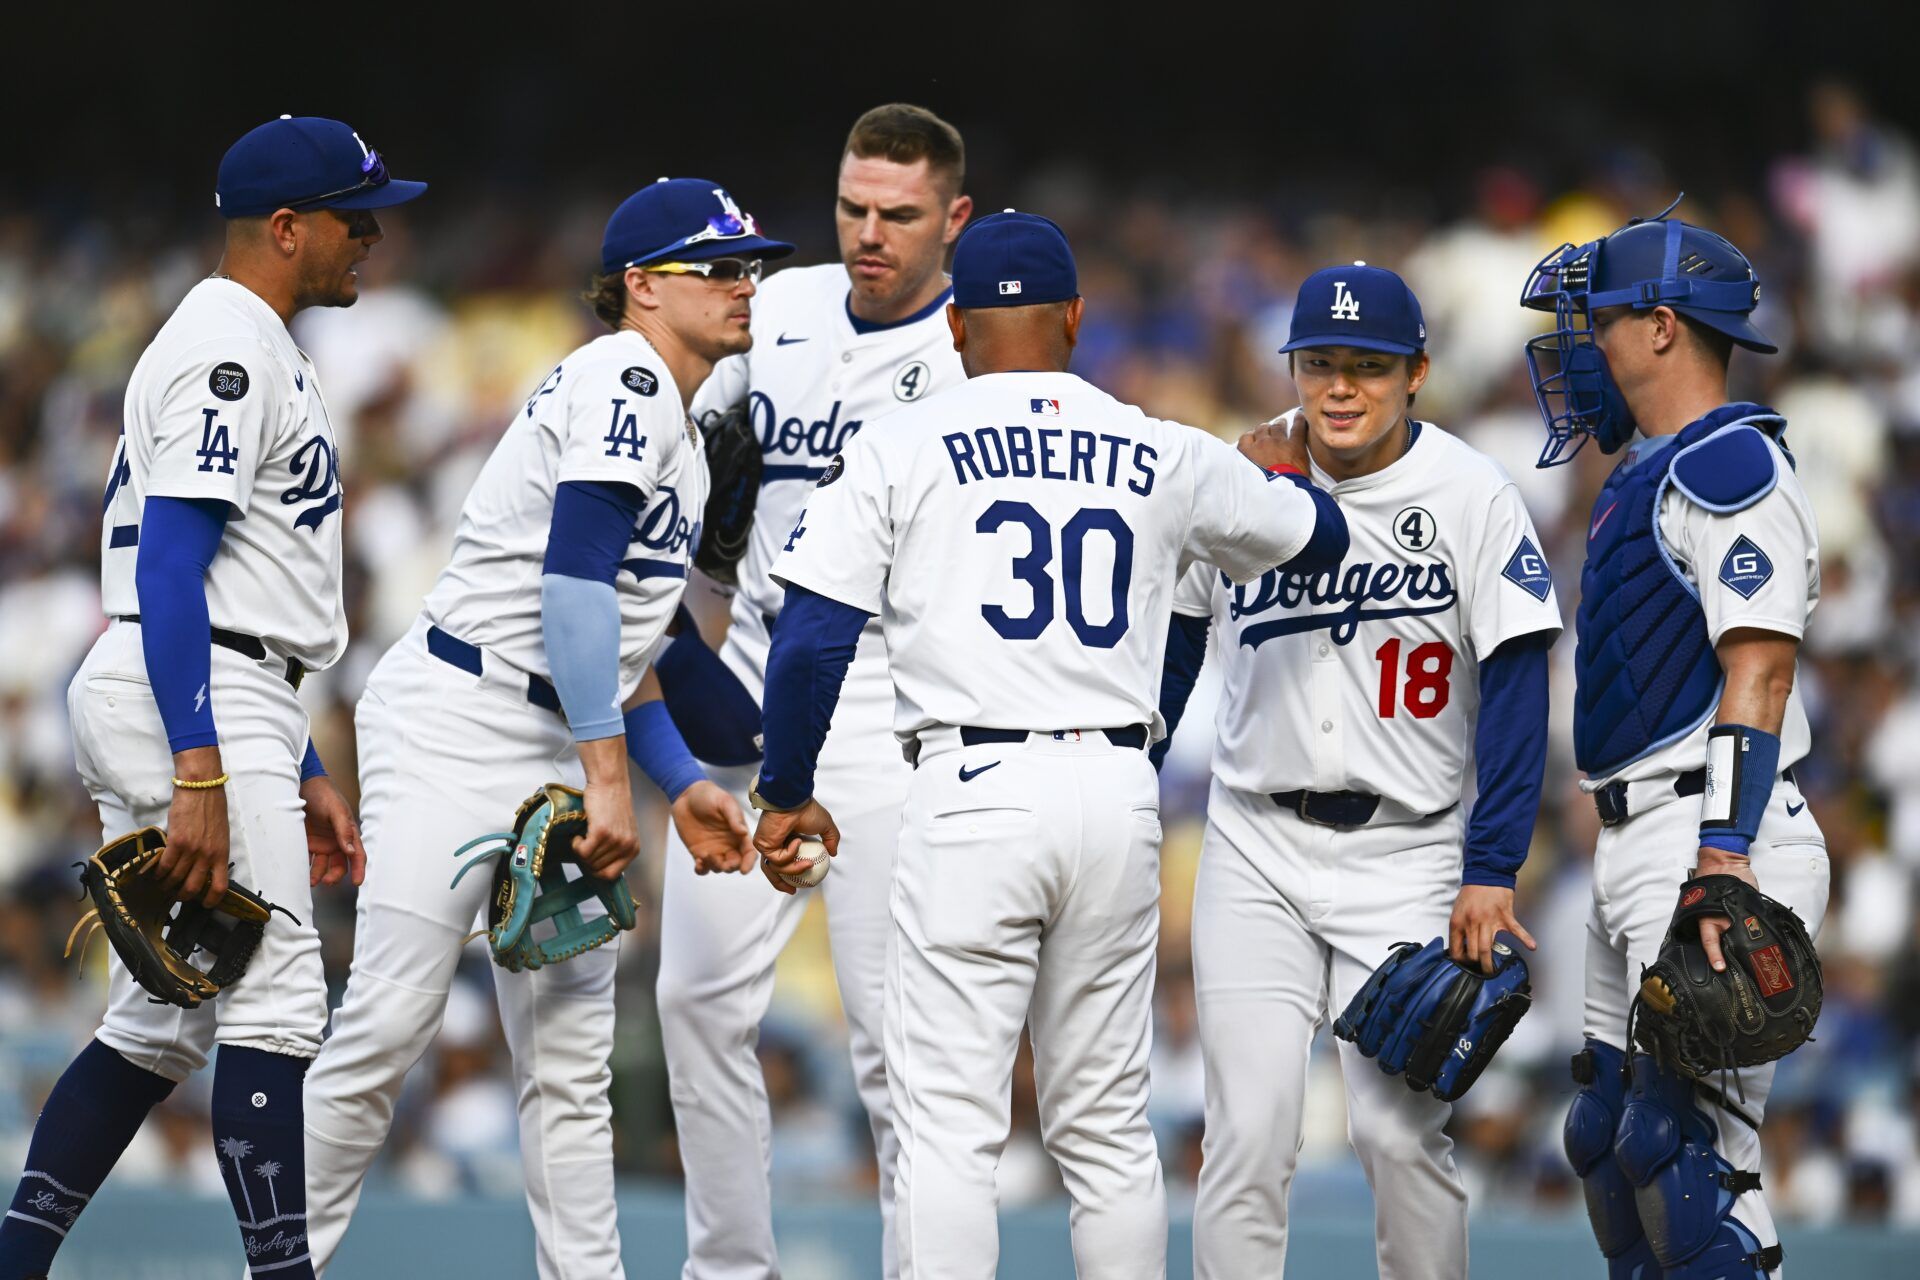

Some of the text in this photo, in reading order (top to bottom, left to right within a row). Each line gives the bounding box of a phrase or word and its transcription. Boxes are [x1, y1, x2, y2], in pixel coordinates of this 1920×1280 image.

[1331, 282, 1359, 320] LA
[216, 375, 241, 395] 34
[627, 374, 651, 394] 34
[900, 366, 921, 397] 4
[196, 408, 239, 475] LA
[603, 398, 648, 462] LA
[942, 426, 1158, 497] ROBERTS
[1400, 511, 1423, 547] 4
[975, 499, 1134, 649] 30
[1520, 554, 1542, 575] G
[1732, 552, 1757, 574] G
[1376, 637, 1454, 719] 18
[1454, 1038, 1472, 1060] 18
[27, 1191, 57, 1211] Los
[245, 1235, 262, 1257] Los
